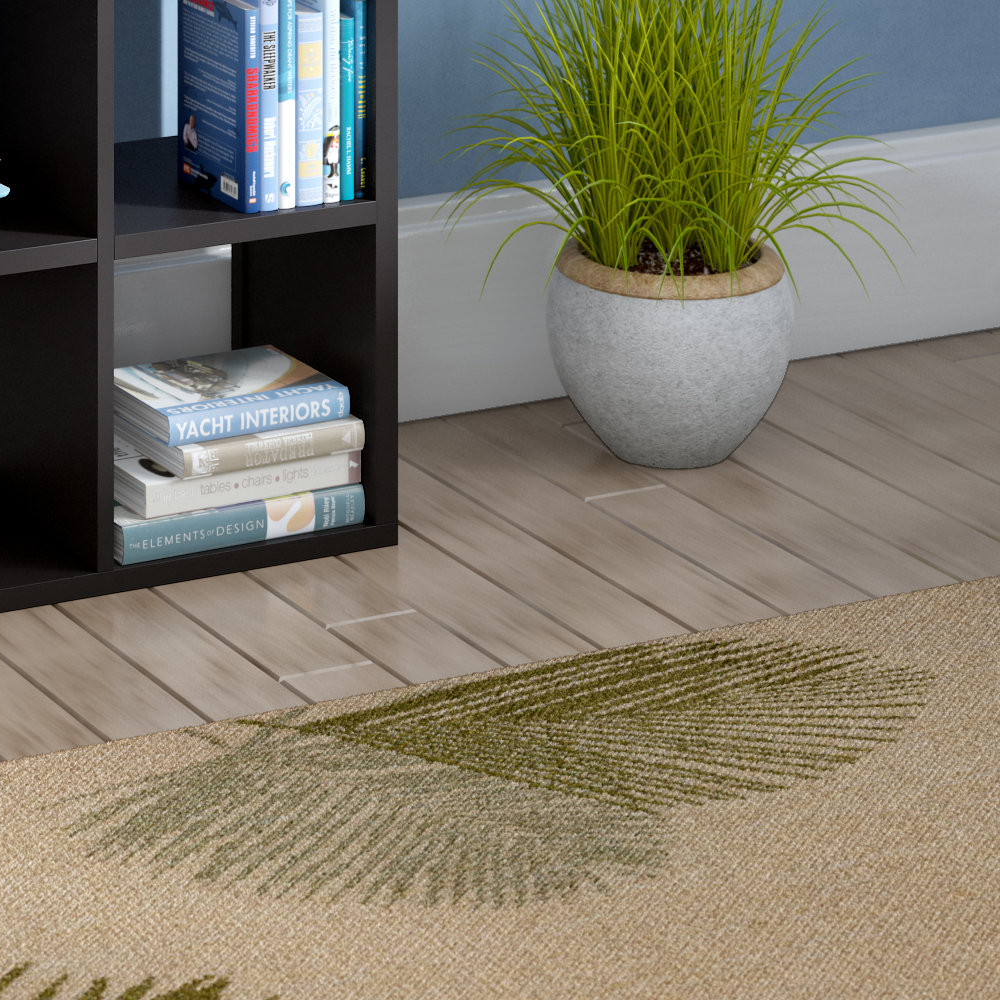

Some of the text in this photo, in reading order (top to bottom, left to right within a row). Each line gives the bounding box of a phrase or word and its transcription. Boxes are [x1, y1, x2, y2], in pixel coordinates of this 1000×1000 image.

[263, 31, 276, 91] THE SLEEPWALKER
[245, 67, 258, 153] SHARKONOMICS
[167, 382, 340, 415] YACHT INTERIORS
[175, 398, 331, 441] YACHT INTERIORS
[244, 445, 315, 467] PREDATOR
[200, 479, 232, 496] tables
[241, 472, 273, 489] chairs
[282, 466, 310, 483] lights
[142, 529, 206, 550] ELEMENTS
[216, 519, 265, 537] DESIGN
